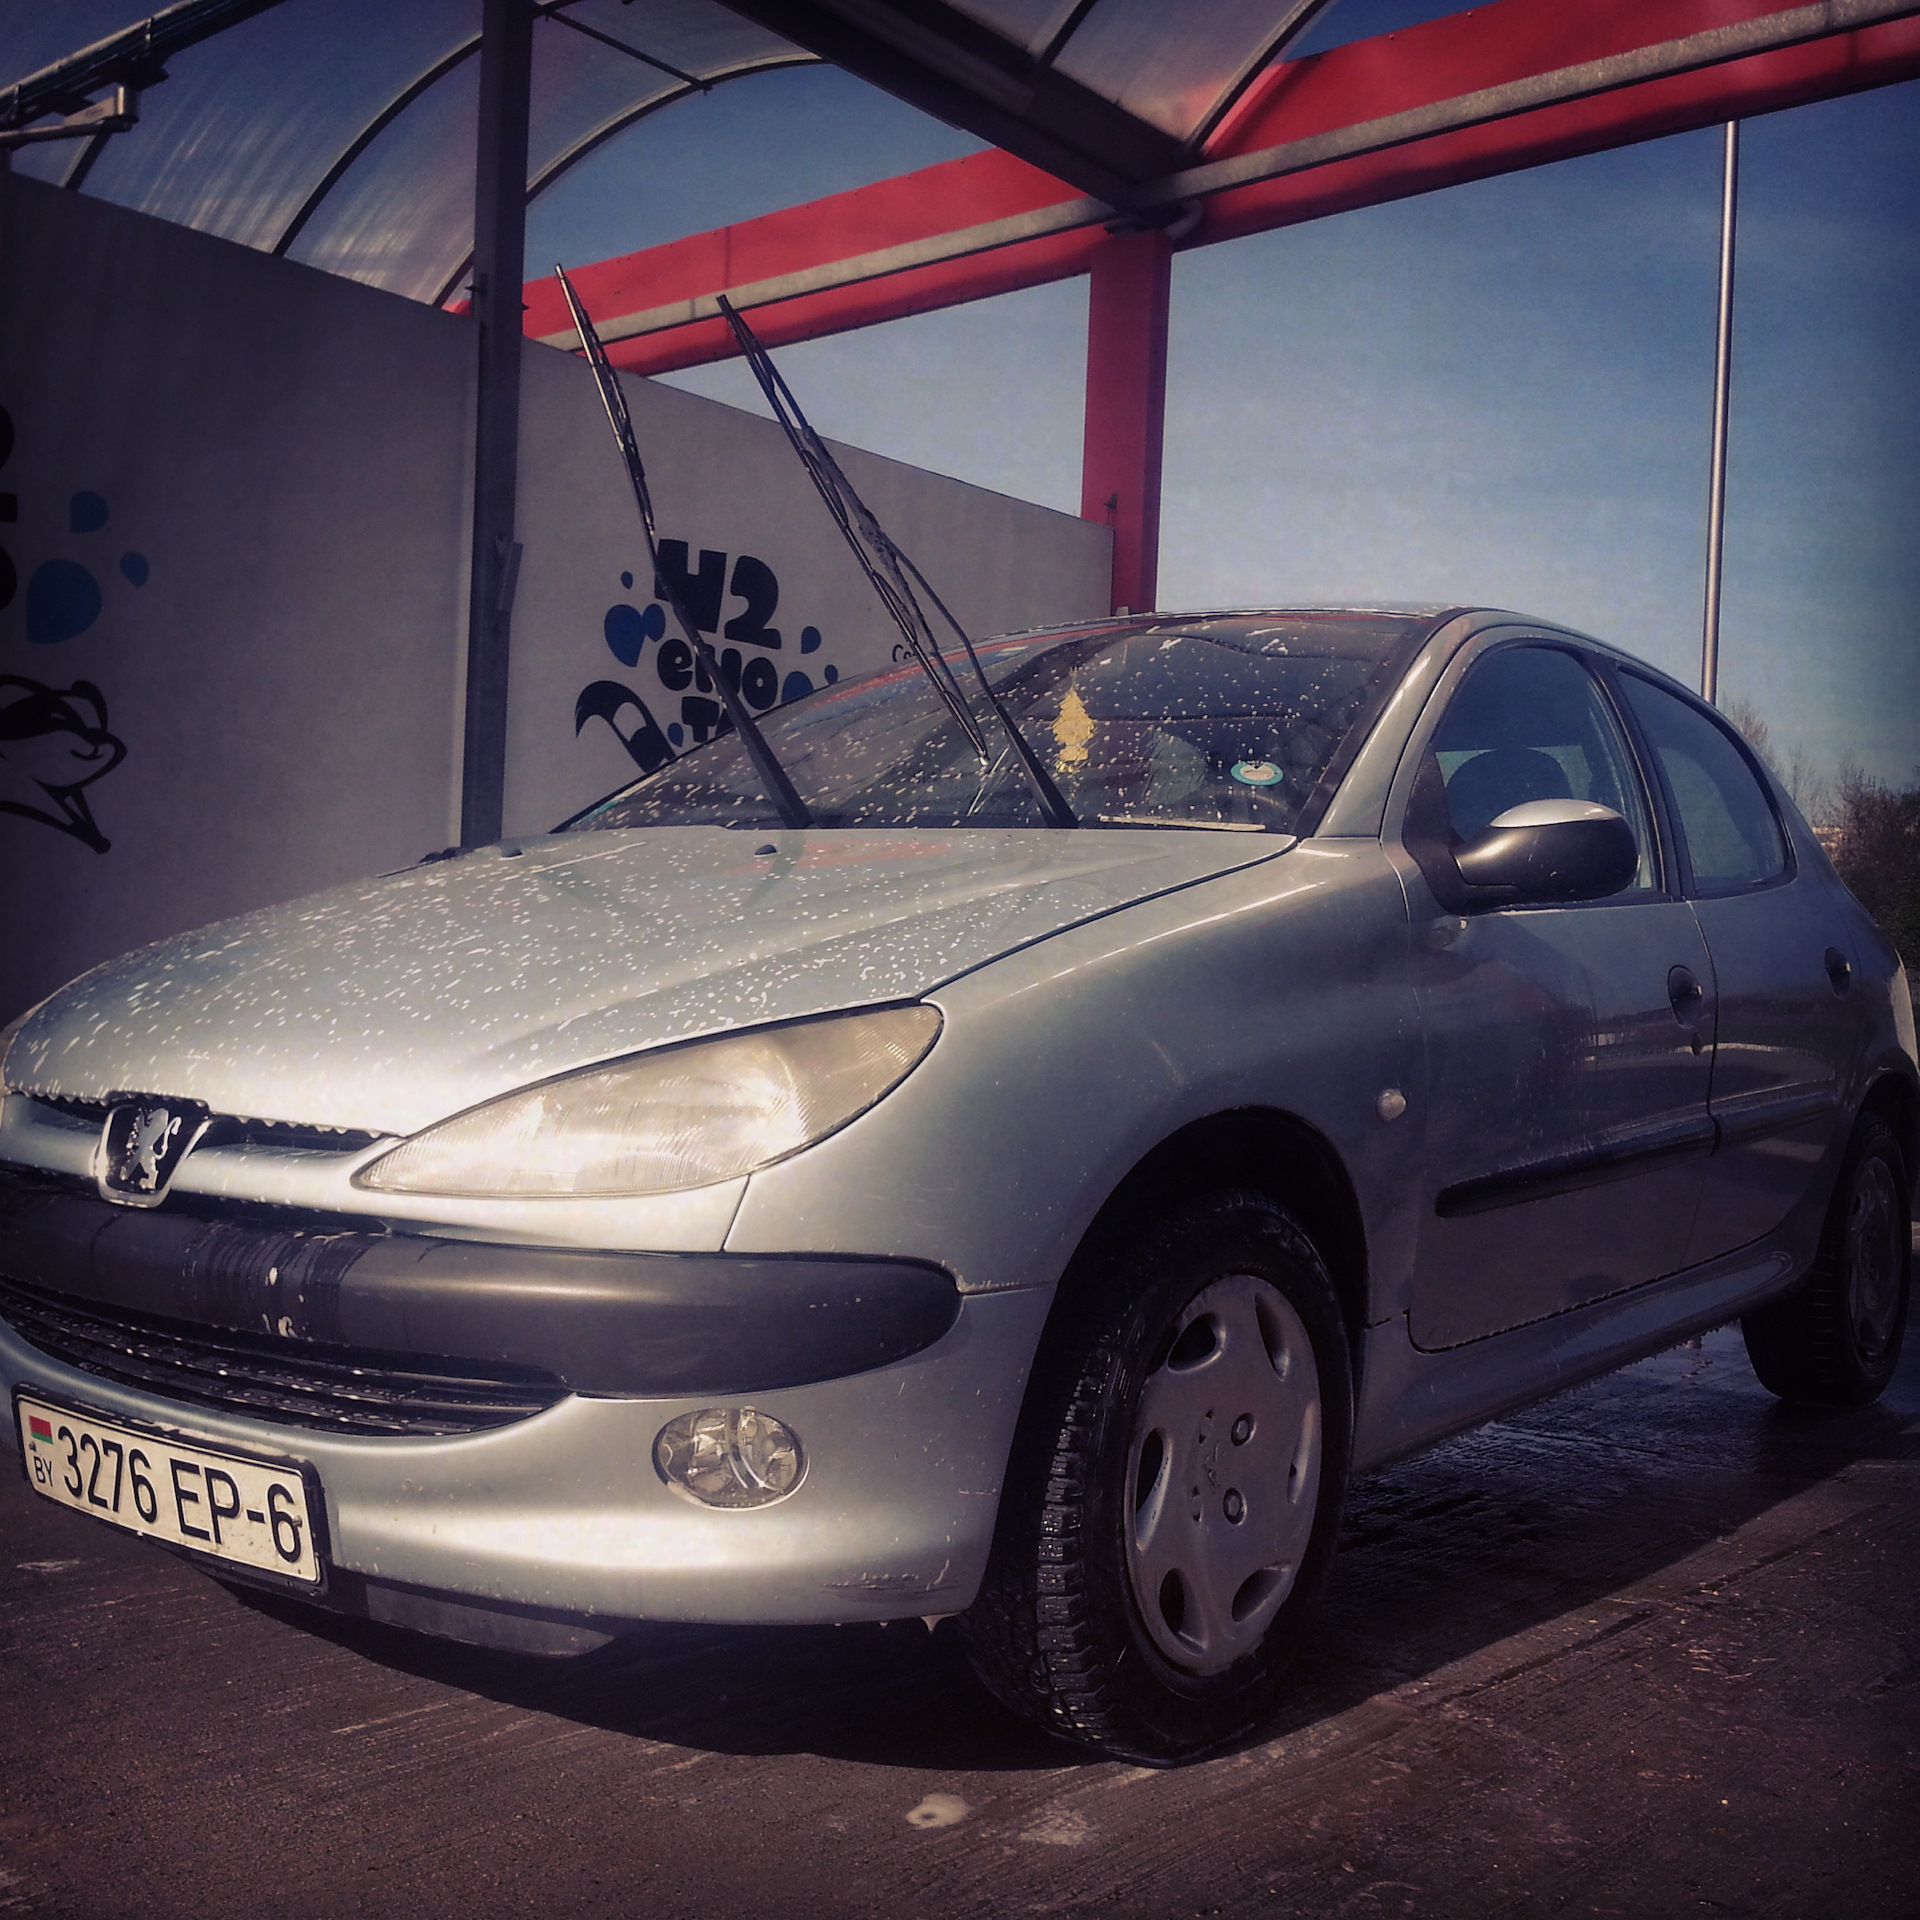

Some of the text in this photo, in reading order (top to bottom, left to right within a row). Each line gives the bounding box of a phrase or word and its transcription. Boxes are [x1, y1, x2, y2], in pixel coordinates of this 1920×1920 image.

[33, 1455, 54, 1487] BY
[58, 1425, 302, 1563] 3276 EP-6
